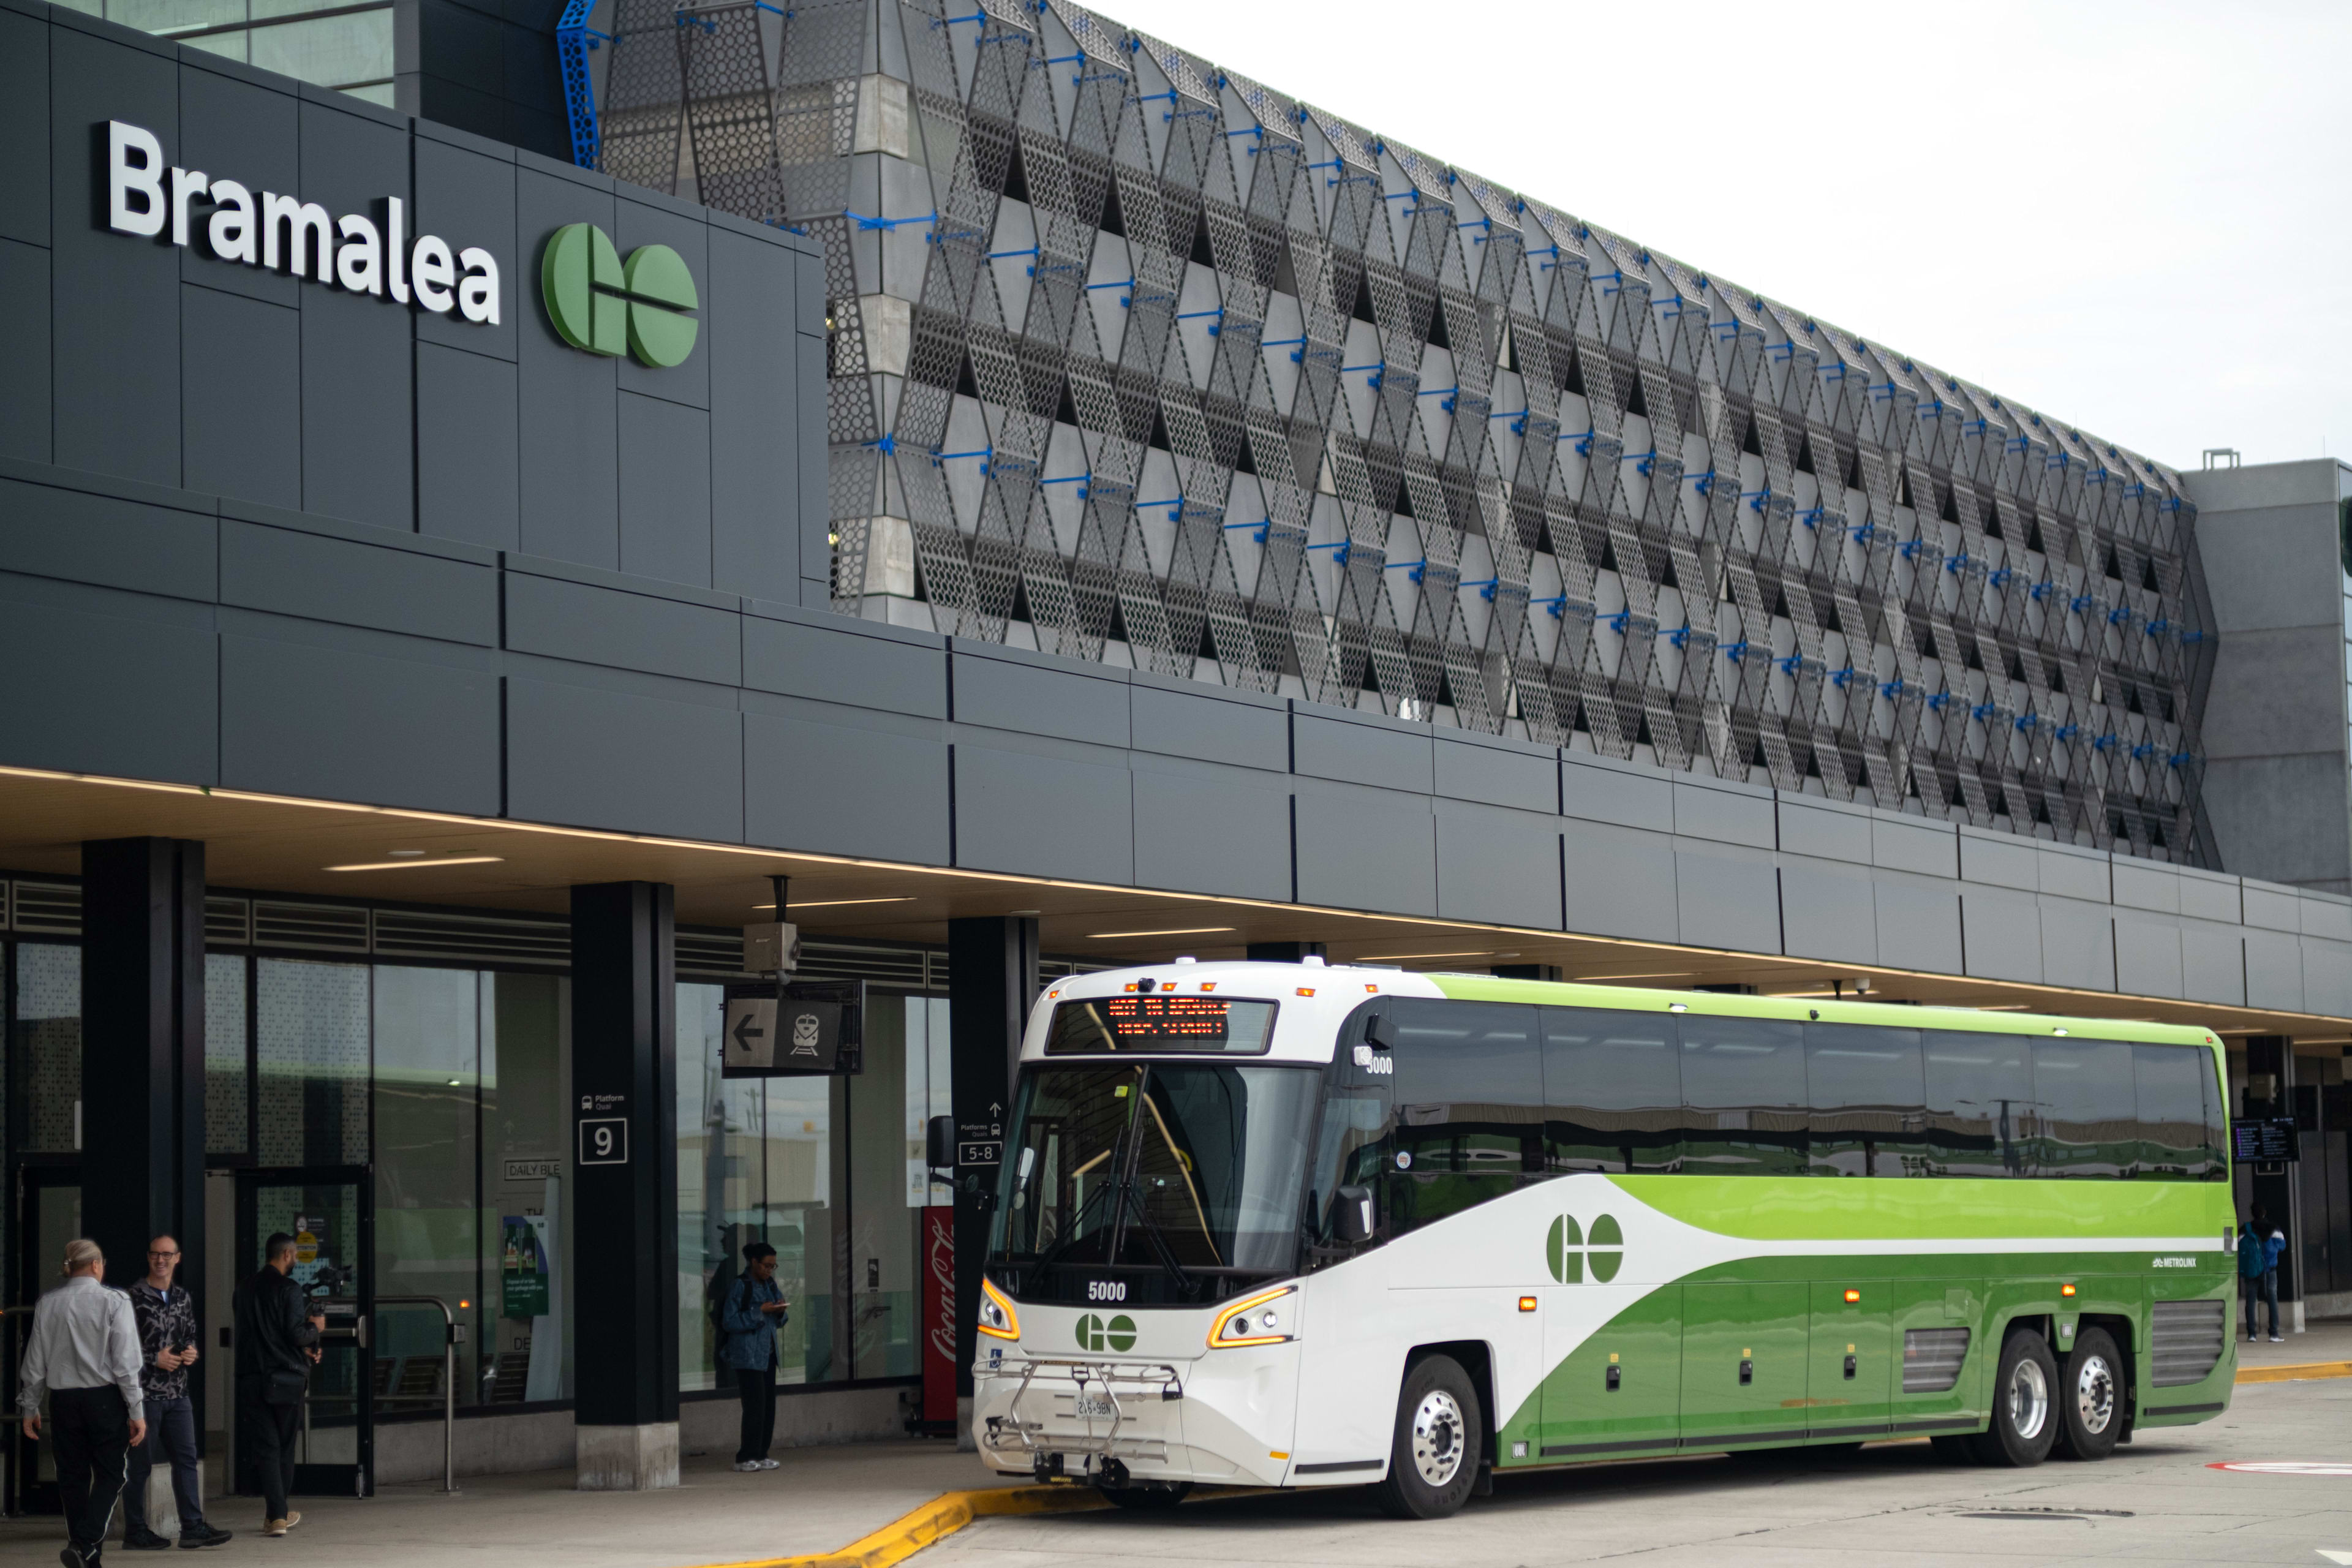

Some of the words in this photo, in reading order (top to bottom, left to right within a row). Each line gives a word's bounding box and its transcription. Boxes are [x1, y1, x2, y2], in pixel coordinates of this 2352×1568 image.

[108, 120, 500, 326] Bramalea
[595, 1127, 612, 1156] 9
[969, 1147, 992, 1160] 5-8
[510, 1165, 537, 1175] DAILY
[1547, 1213, 1624, 1284] GO
[2164, 1257, 2196, 1268] METROLINX
[1088, 1281, 1125, 1301] 5000
[1075, 1313, 1137, 1352] GO
